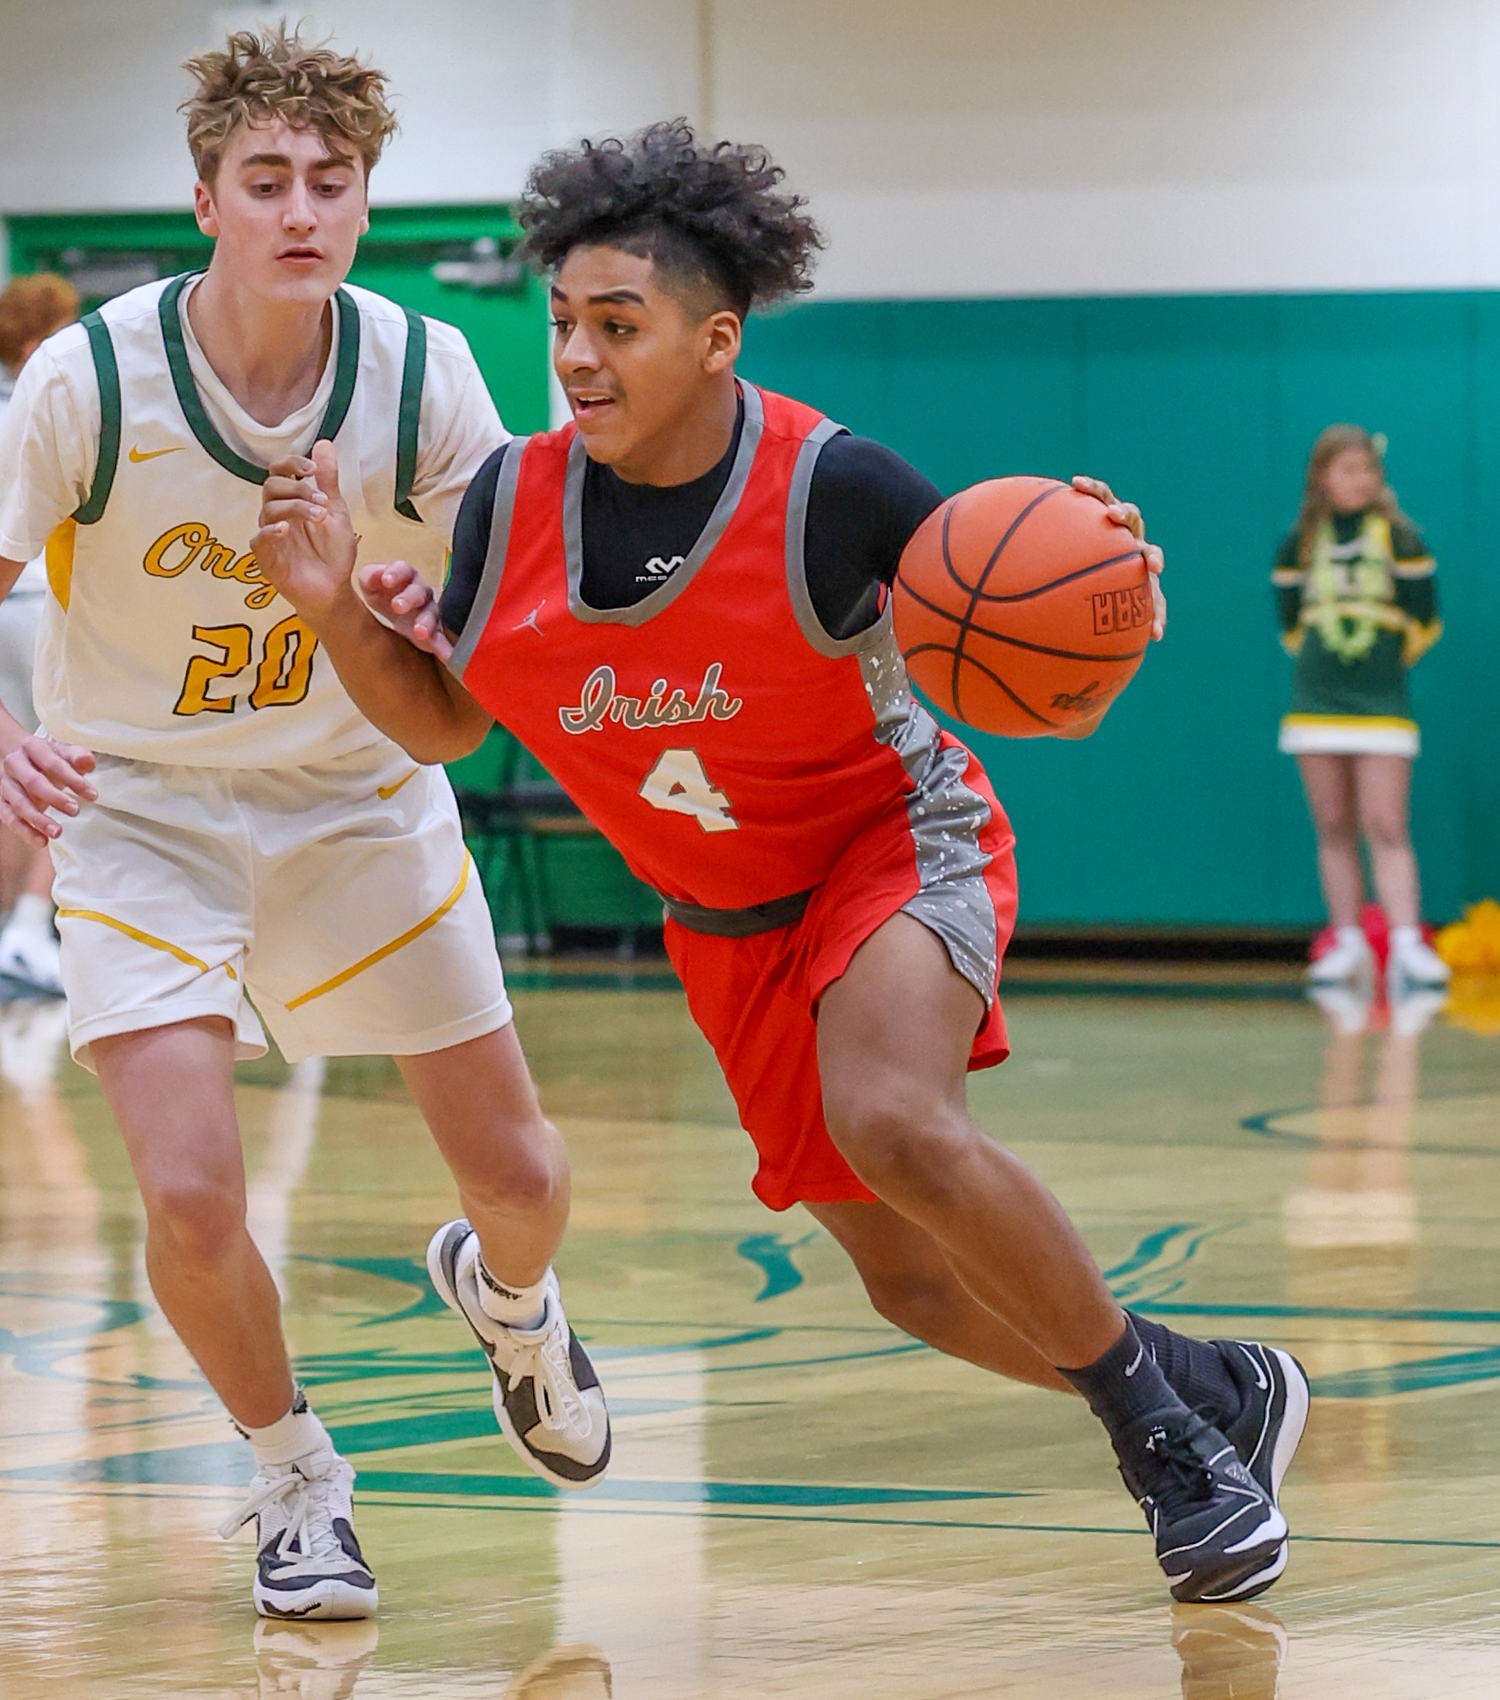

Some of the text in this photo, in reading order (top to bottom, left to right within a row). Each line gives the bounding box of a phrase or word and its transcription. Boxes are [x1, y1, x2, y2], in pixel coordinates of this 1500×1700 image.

[172, 613, 319, 716] 20
[558, 662, 743, 735] Irish
[638, 747, 740, 833] 4
